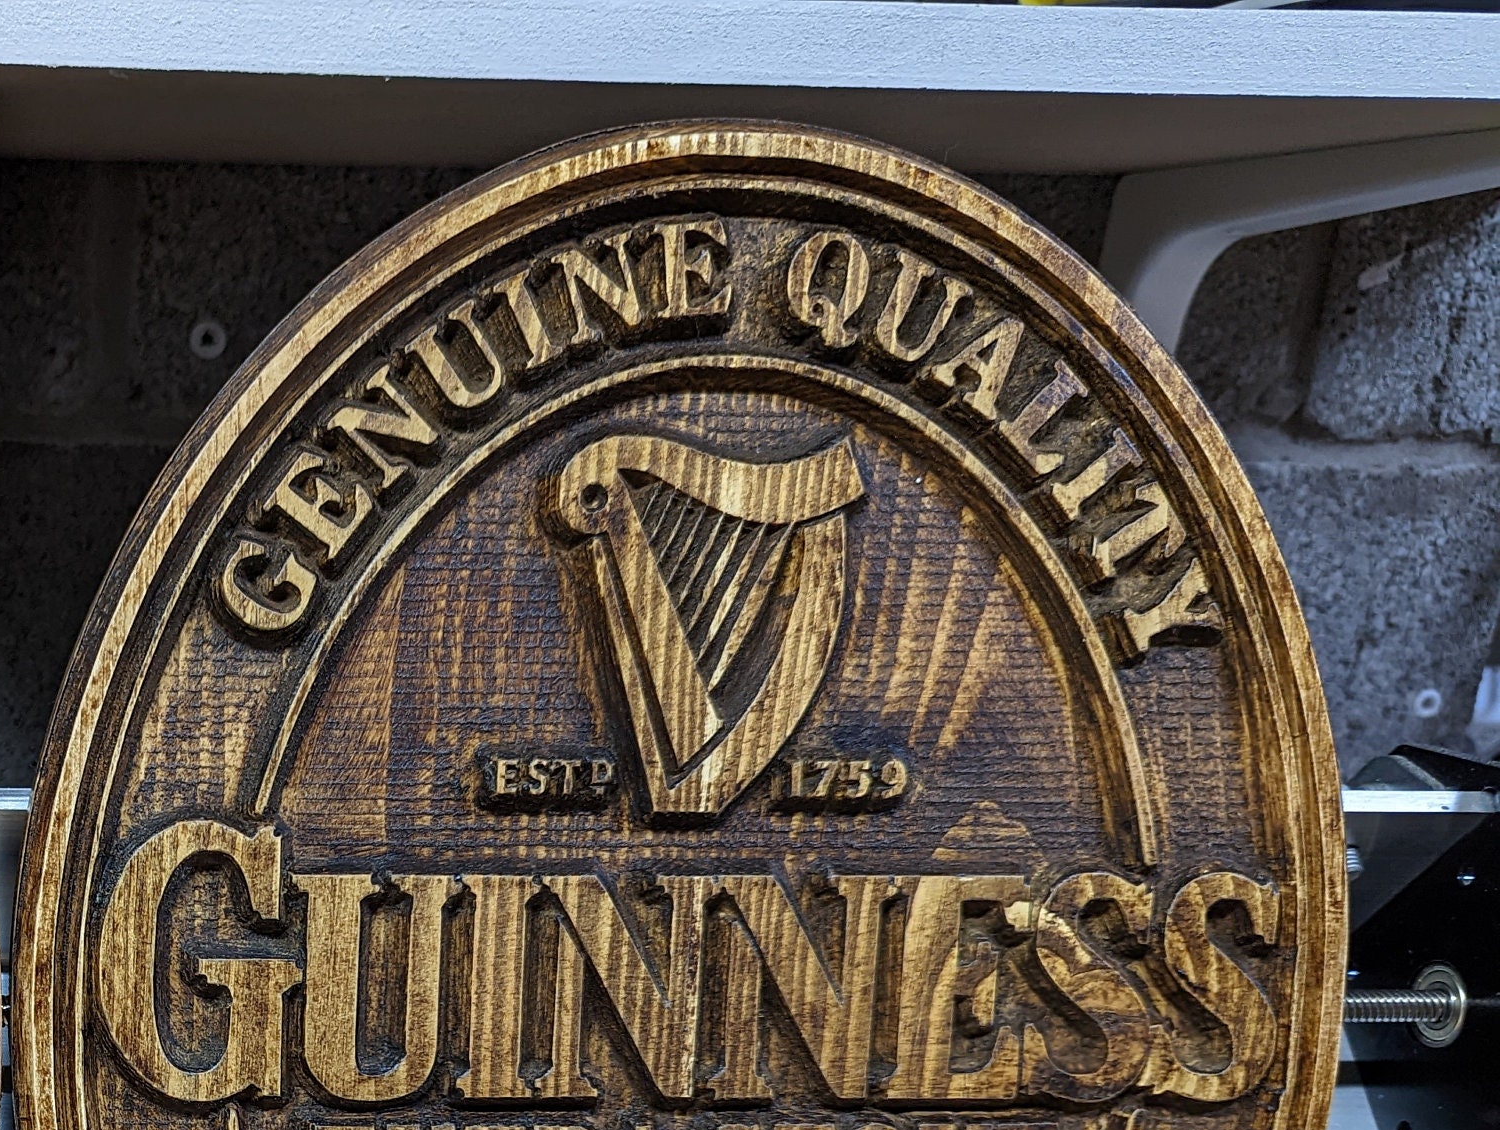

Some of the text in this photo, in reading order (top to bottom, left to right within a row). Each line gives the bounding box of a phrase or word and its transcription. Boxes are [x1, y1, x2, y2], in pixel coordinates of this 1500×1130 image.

[222, 219, 1224, 651] GENUINE QUALITY
[790, 759, 908, 798] 1759
[99, 820, 1279, 1102] GUINNESS
